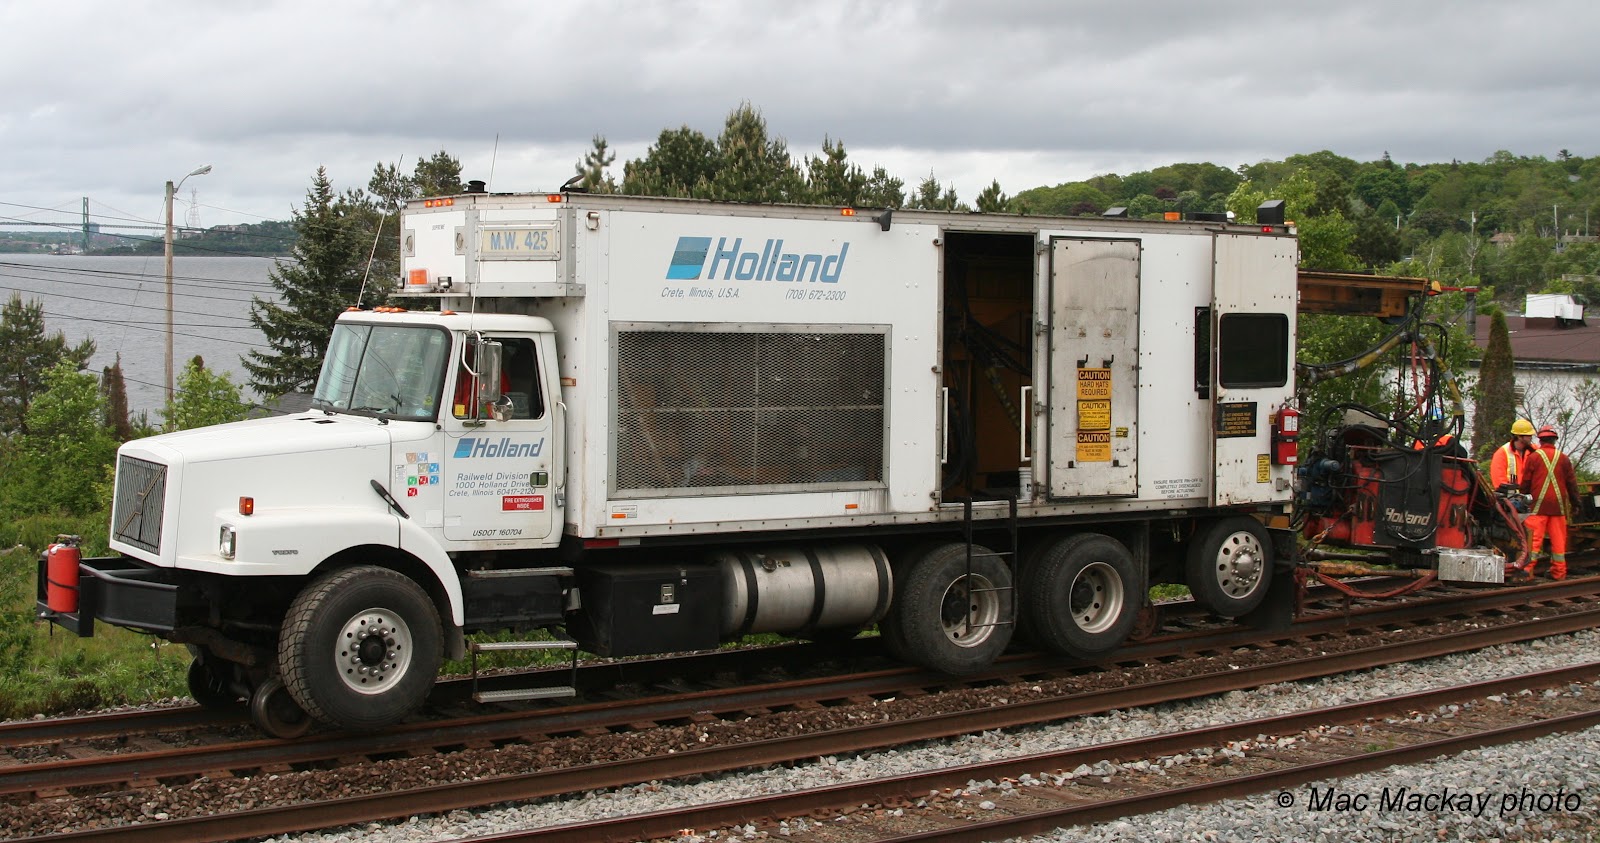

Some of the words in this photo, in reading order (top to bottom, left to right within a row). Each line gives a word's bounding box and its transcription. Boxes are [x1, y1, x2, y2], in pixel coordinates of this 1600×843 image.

[490, 231, 519, 250] M.W.
[525, 231, 548, 250] 425
[707, 237, 850, 284] Holland
[661, 287, 685, 299] Crete,
[689, 287, 714, 299] Illinois,
[717, 288, 740, 298] U.S.A.
[785, 289, 807, 300] (708)
[808, 290, 847, 301] 672-2300
[1079, 371, 1110, 380] CAUTION
[1081, 388, 1108, 396] REQUIRED
[1078, 433, 1109, 443] CAUTION
[472, 437, 545, 458] Holland
[457, 472, 493, 481] Railweld
[496, 472, 529, 480] Division
[511, 480, 530, 488] Drive
[496, 488, 536, 496] 60417-2120
[472, 529, 497, 537] USDOT
[498, 528, 523, 536] 160704
